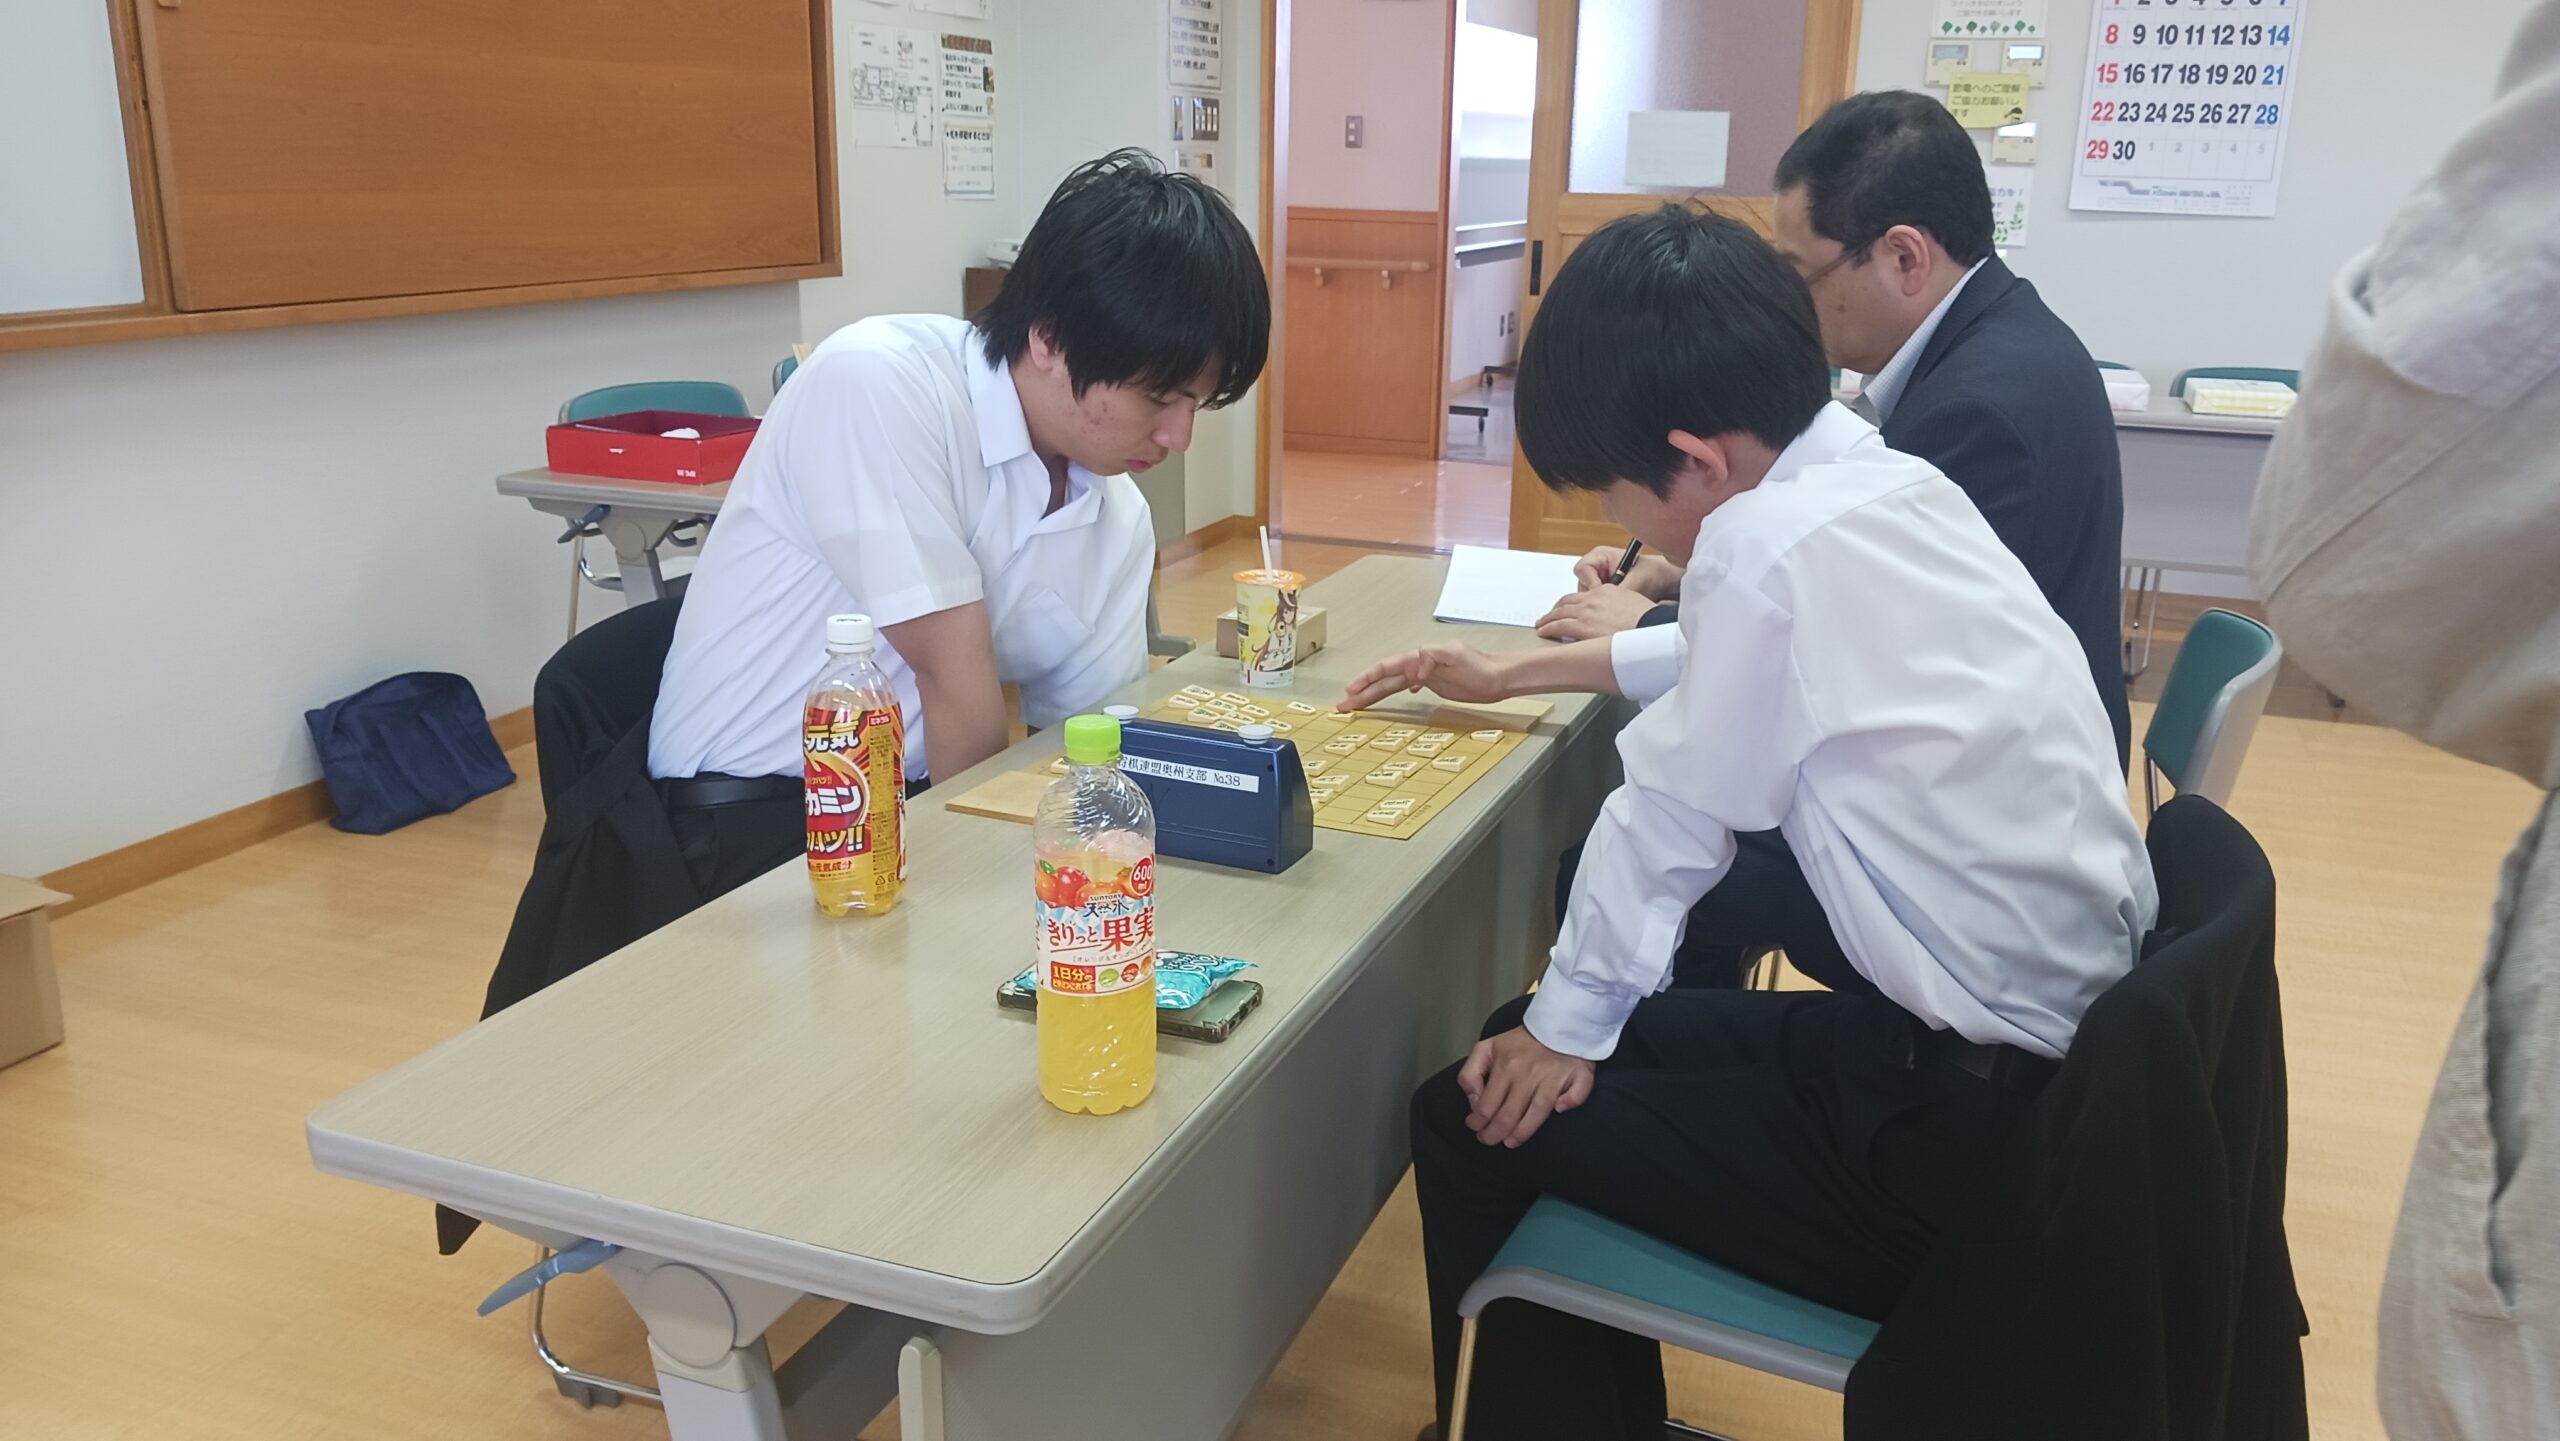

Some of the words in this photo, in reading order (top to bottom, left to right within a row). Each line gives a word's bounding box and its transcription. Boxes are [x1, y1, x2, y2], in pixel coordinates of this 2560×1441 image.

[2105, 24, 2119, 44] 8
[2132, 24, 2146, 44] 9
[2156, 24, 2179, 45] 10
[2185, 24, 2205, 45] 11
[2211, 24, 2235, 45] 12
[2240, 25, 2262, 45] 13
[2267, 25, 2290, 46] 14
[2097, 63, 2118, 83] 15
[2123, 64, 2146, 83] 16
[2151, 64, 2173, 84] 17
[2178, 64, 2201, 84] 18
[2205, 64, 2229, 84] 19
[2232, 65, 2256, 84] 20
[2261, 65, 2284, 85] 21
[2091, 102, 2114, 121] 22
[2118, 102, 2141, 122] 23
[2144, 103, 2168, 122] 24
[2172, 103, 2195, 123] 25
[2199, 104, 2222, 123] 26
[2226, 104, 2251, 124] 27
[2254, 104, 2279, 124] 28
[2086, 140, 2109, 159] 29
[2112, 140, 2136, 160] 30
[2149, 142, 2155, 152] 1
[2174, 142, 2183, 152] 2
[2202, 142, 2210, 153] 3
[2230, 143, 2238, 153] 4
[2257, 144, 2265, 154] 5
[1134, 865, 1152, 881] 600
[1083, 899, 1130, 917] 天然水
[1053, 966, 1093, 981] 1日分の
